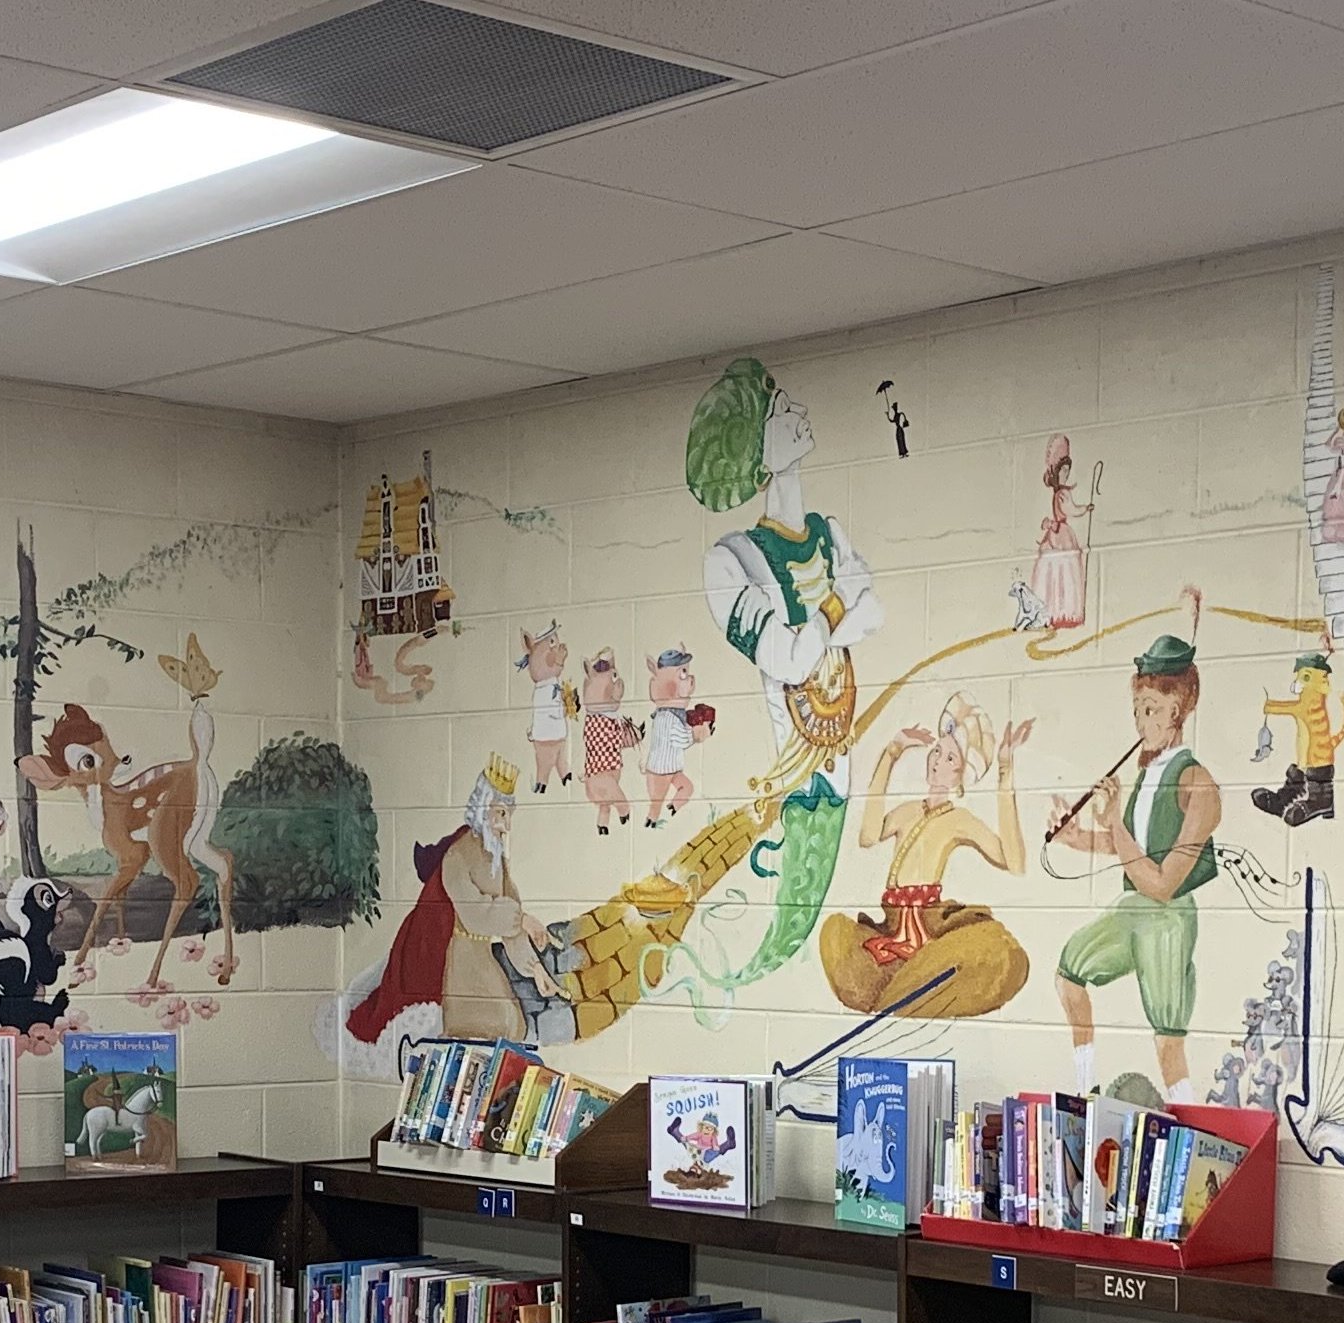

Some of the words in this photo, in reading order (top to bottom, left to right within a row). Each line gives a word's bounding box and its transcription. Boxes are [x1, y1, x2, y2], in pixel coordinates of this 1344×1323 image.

[666, 1090, 720, 1116] SQUISH!
[879, 1205, 899, 1225] Seuss
[1000, 1266, 1008, 1279] S
[1103, 1275, 1147, 1301] EASY
